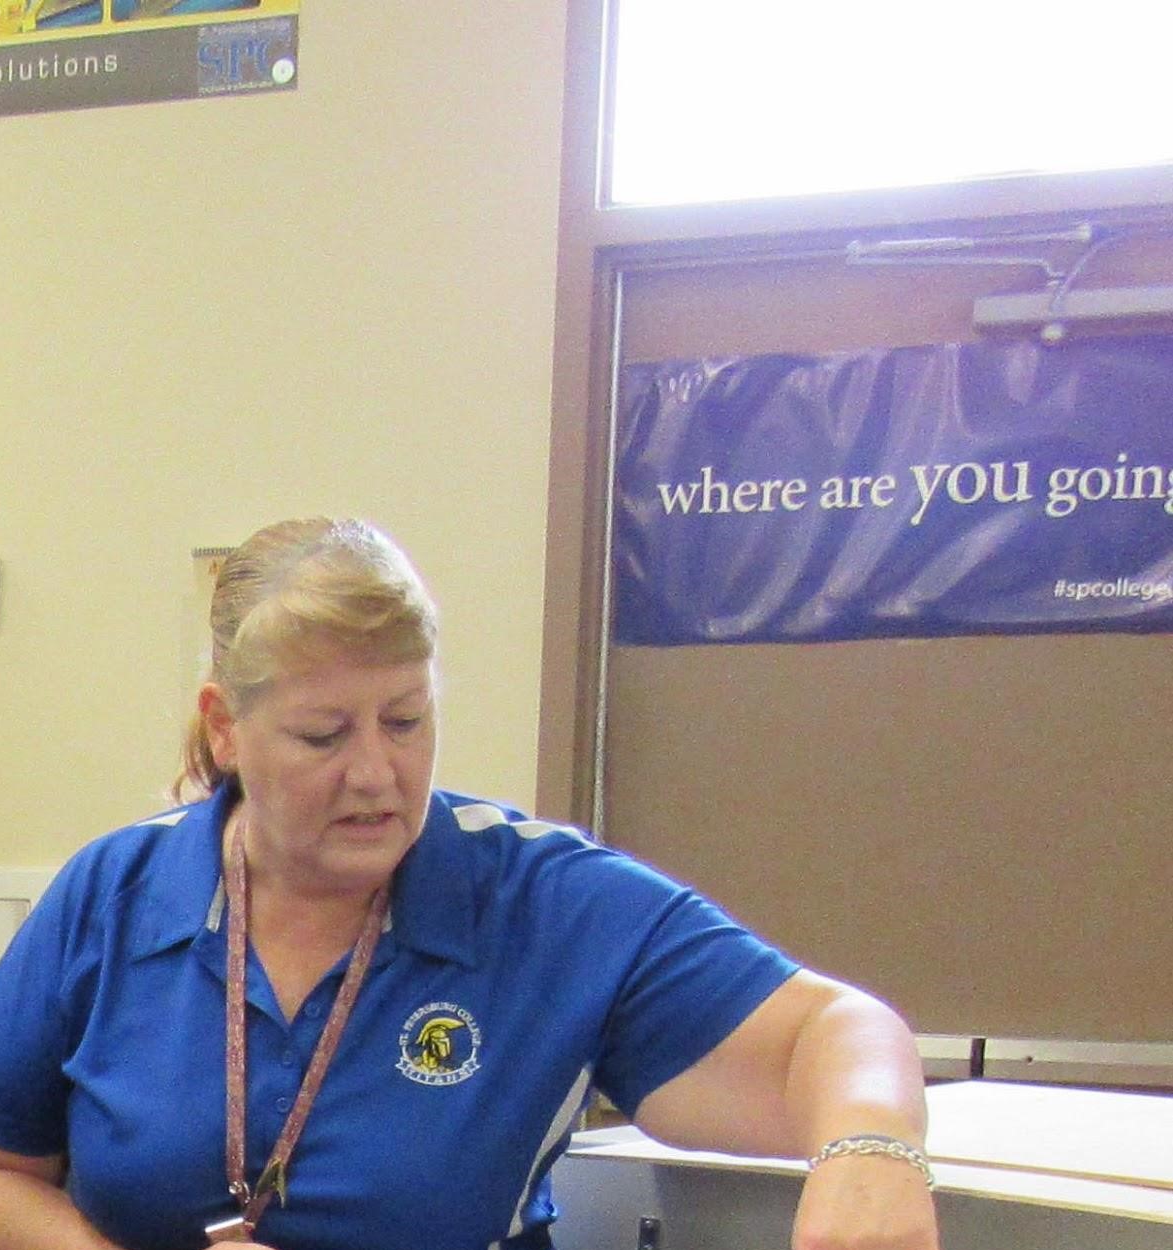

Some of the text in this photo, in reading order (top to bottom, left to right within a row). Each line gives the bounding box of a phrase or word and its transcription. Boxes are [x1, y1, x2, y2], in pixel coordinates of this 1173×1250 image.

[657, 467, 807, 515] where
[819, 474, 896, 511] are
[910, 461, 1032, 525] you
